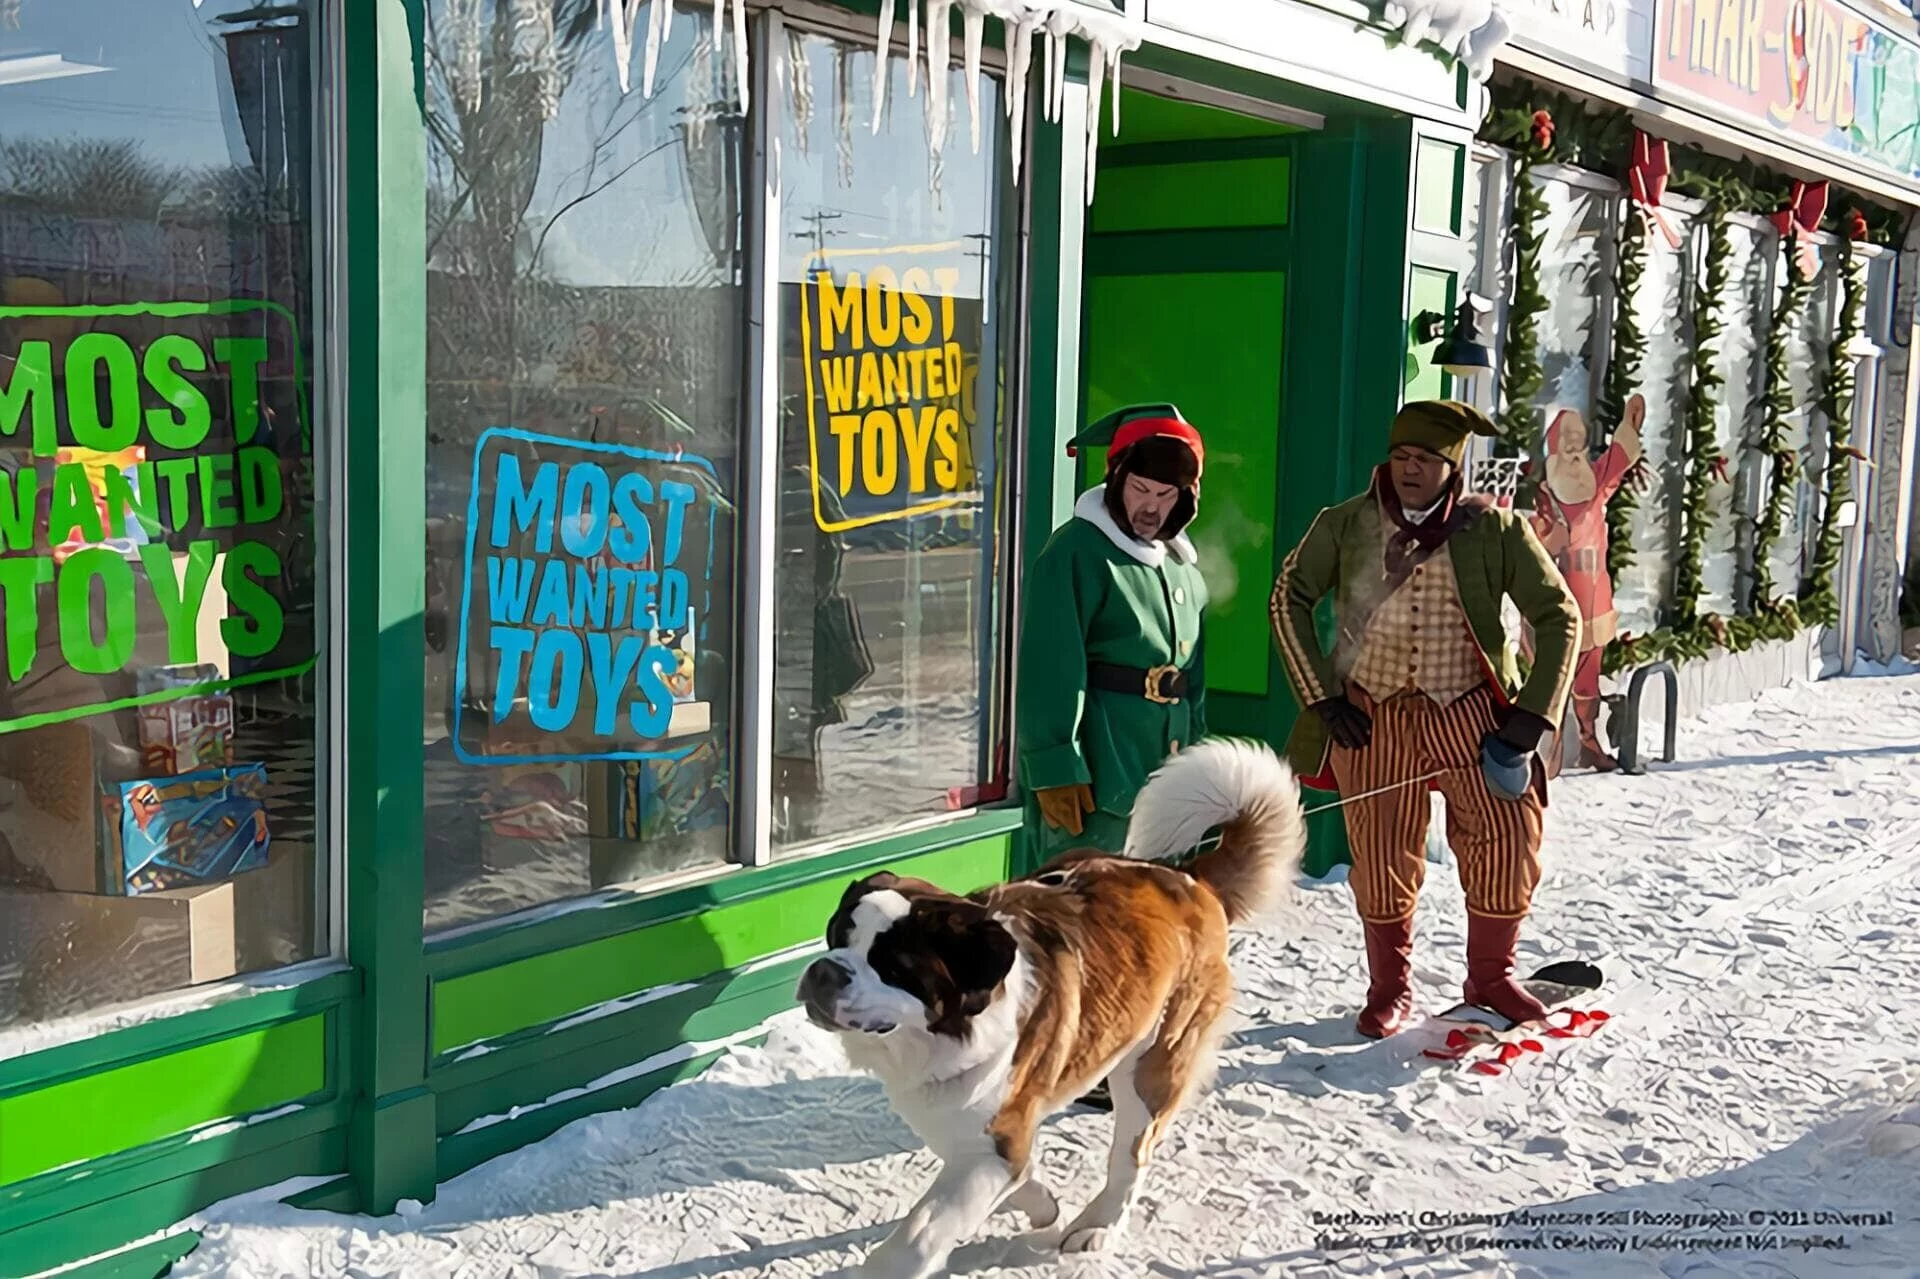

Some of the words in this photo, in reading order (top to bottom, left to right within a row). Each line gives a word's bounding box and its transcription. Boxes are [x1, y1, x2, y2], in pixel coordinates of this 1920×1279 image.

[815, 264, 961, 351] MOST
[0, 332, 269, 457] MOST
[819, 341, 963, 414] WANTED
[829, 405, 960, 498] TOYS
[490, 452, 697, 567] MOST
[0, 539, 285, 683] TOYS
[486, 555, 690, 631] WANTED
[489, 626, 678, 739] TOYS
